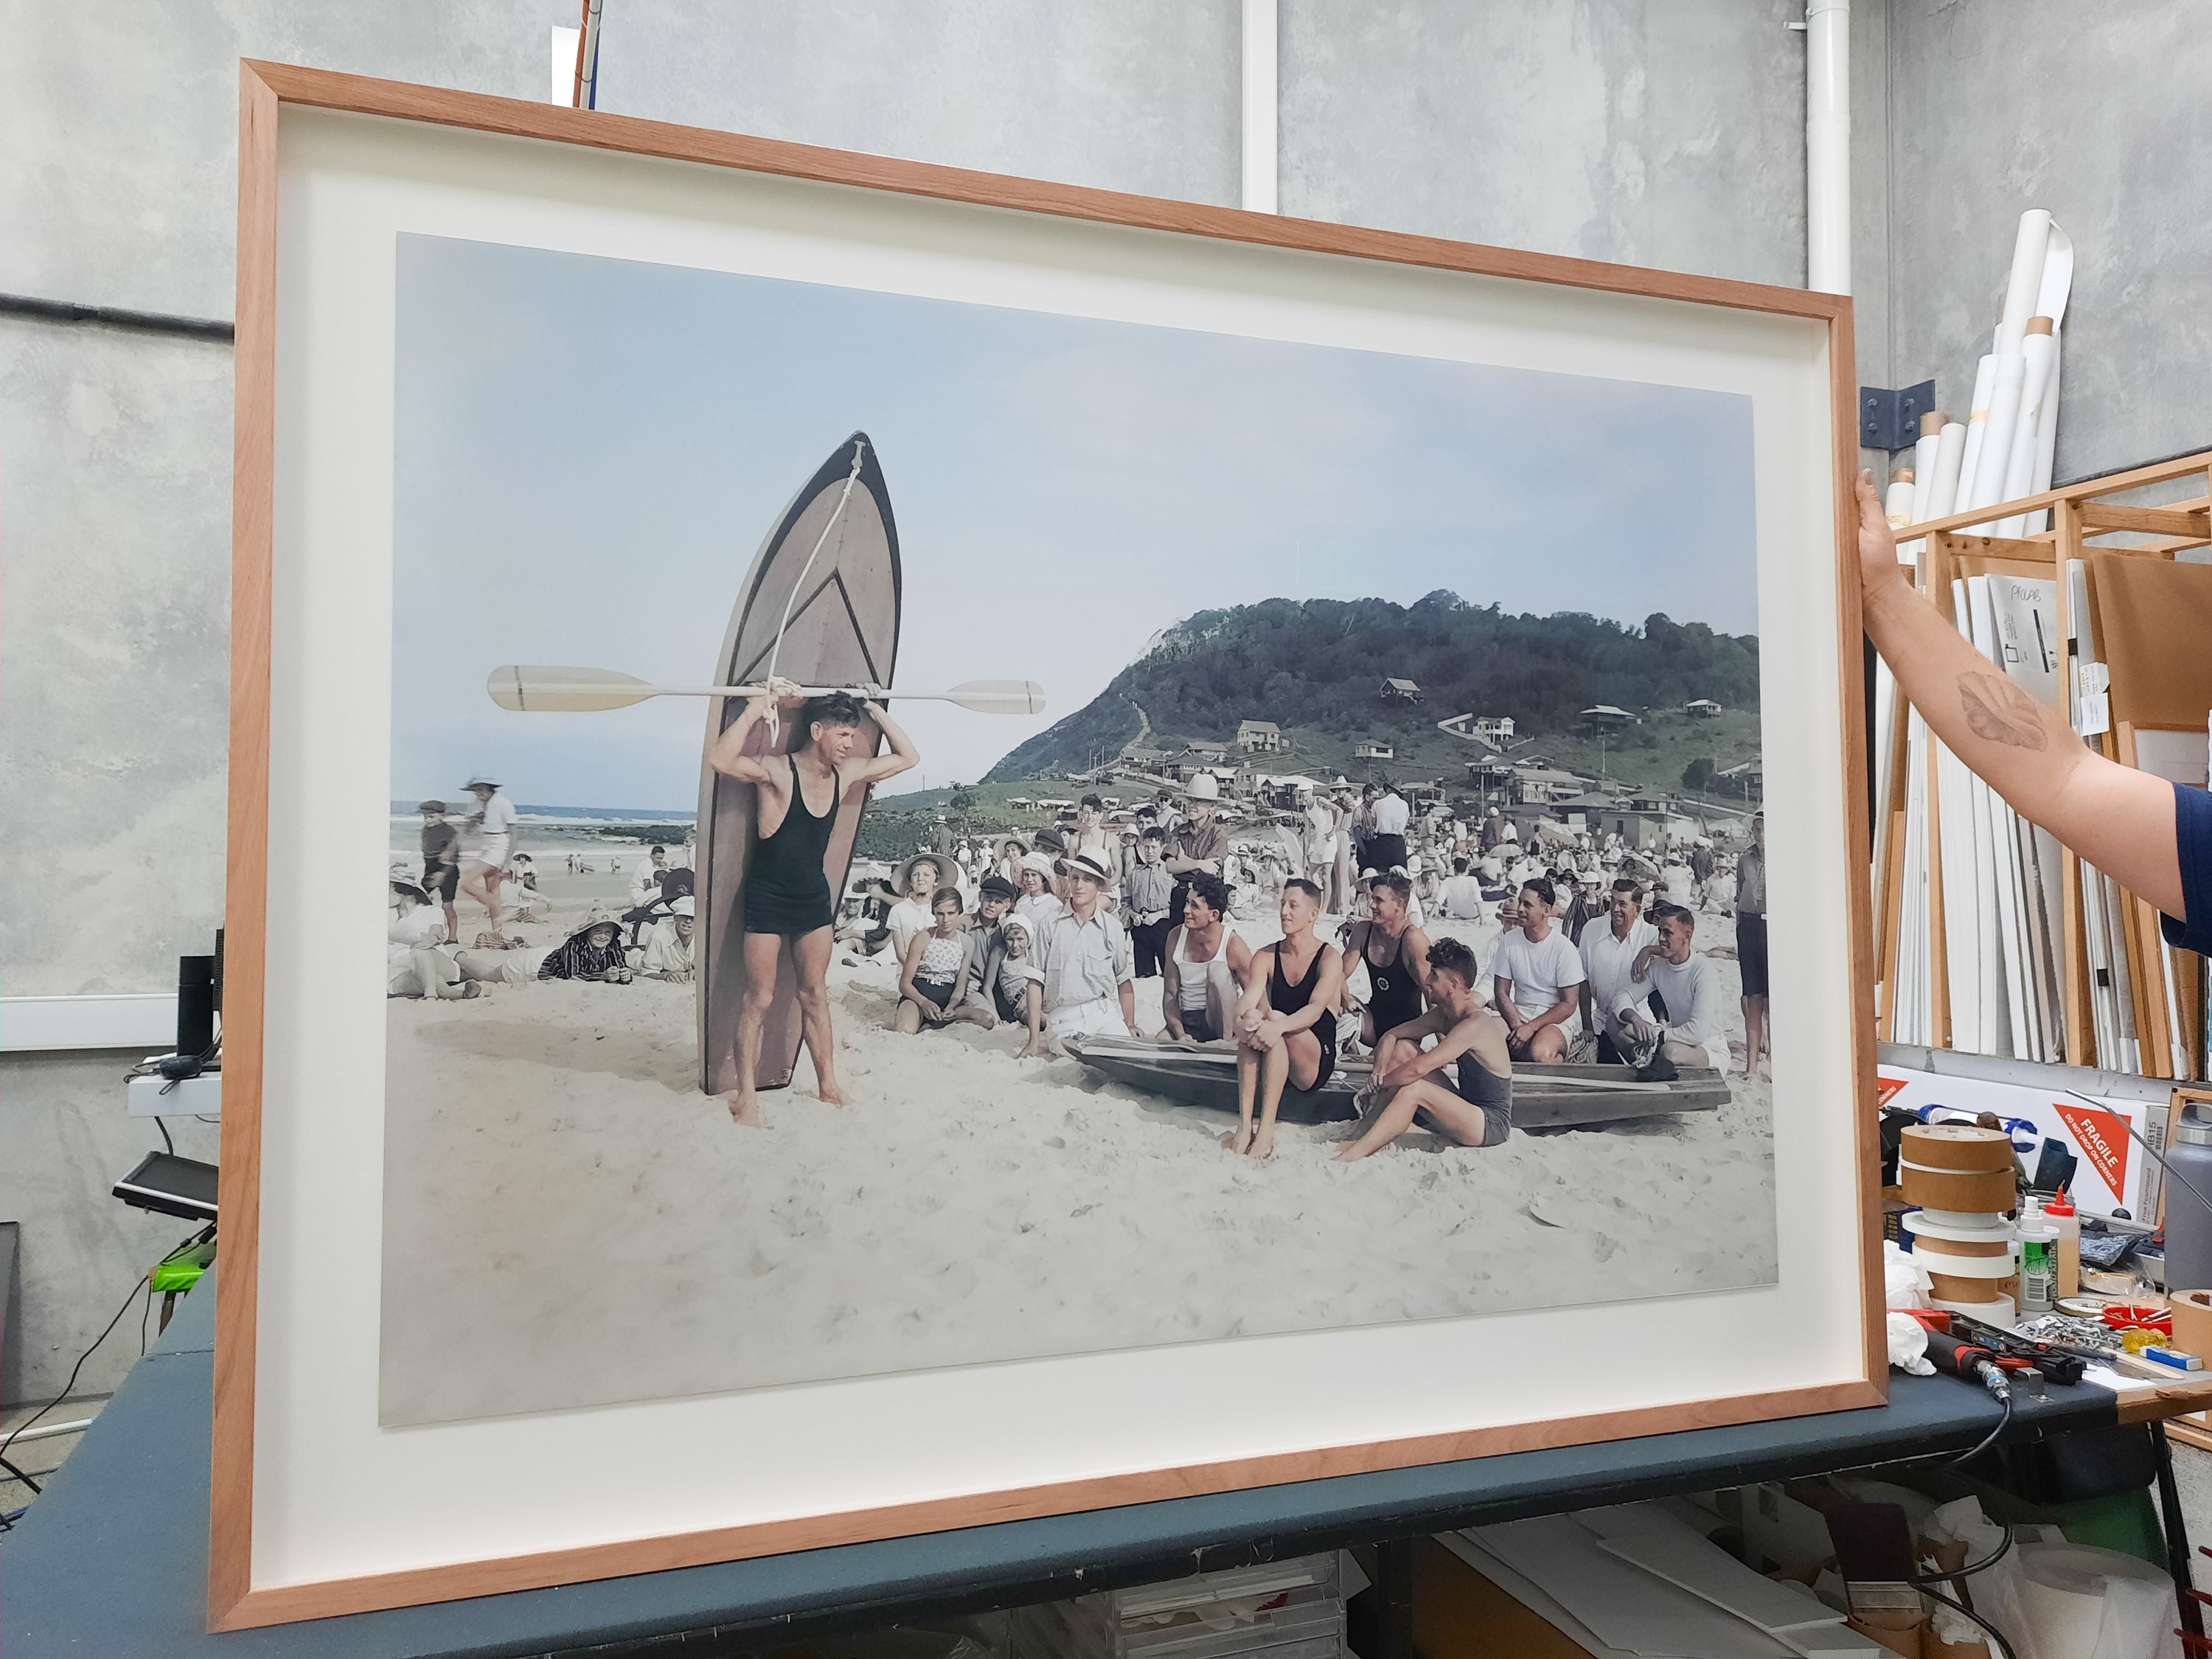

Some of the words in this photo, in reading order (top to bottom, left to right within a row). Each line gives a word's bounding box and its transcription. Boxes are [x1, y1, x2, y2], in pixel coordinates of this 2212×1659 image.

[2065, 1113, 2074, 1124] DO
[2072, 1121, 2083, 1135] NOT
[2079, 1134, 2093, 1151] DROP
[2090, 1150, 2100, 1161] ON
[2096, 1159, 2118, 1186] CORNERS
[2081, 1119, 2118, 1167] FRAGILE
